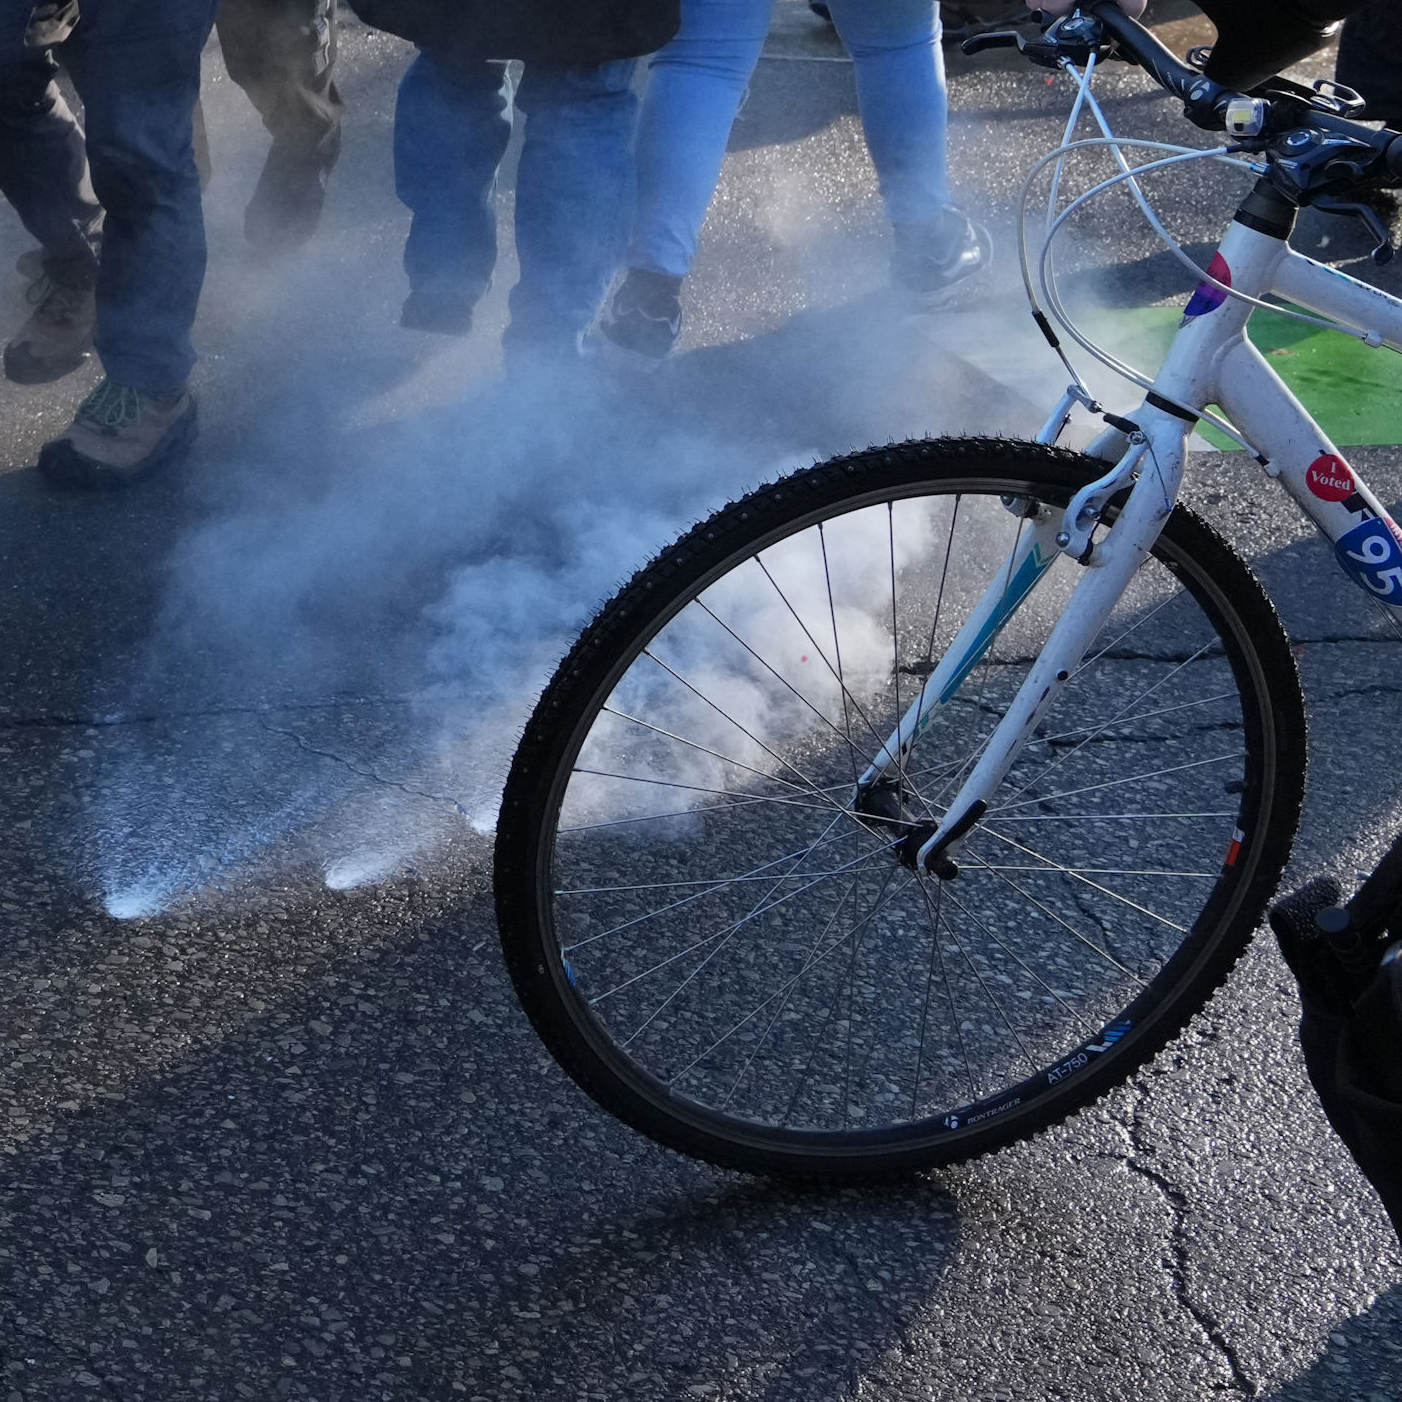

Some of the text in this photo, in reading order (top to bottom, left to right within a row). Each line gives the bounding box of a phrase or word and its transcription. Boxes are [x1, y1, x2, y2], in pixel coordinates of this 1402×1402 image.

[1331, 461, 1337, 474] I
[1311, 470, 1352, 491] Voted
[1047, 1052, 1089, 1085] AT-750
[966, 1097, 1021, 1125] BONTRAGER
